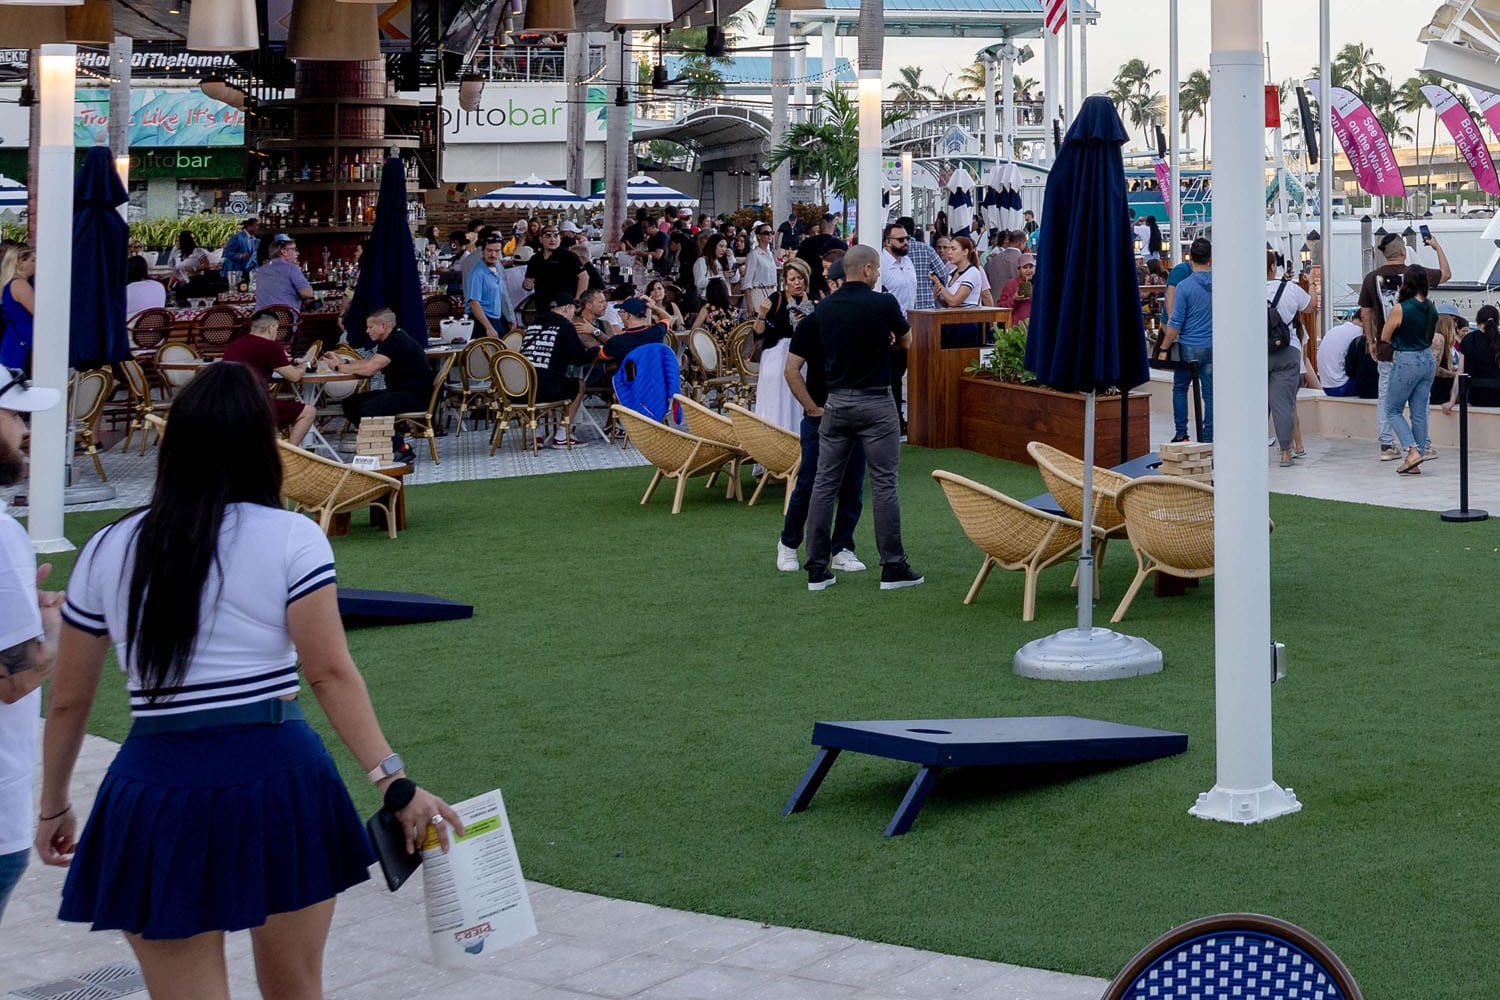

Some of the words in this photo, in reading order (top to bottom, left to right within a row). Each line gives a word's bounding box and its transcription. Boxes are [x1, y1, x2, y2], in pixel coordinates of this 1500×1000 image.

[143, 107, 179, 132] Like
[186, 108, 216, 127] It's
[442, 99, 562, 134] ojitobar
[129, 150, 212, 172] ojitobar
[1331, 114, 1340, 129] on
[1337, 128, 1350, 147] the
[1347, 147, 1362, 178] Water
[1348, 120, 1360, 135] on
[1357, 133, 1370, 151] the
[1367, 150, 1385, 183] Water
[1363, 116, 1379, 137] See
[1374, 137, 1396, 172] Miami
[1455, 131, 1478, 168] Tickets
[1461, 118, 1480, 145] Boat
[1476, 146, 1490, 170] Tour
